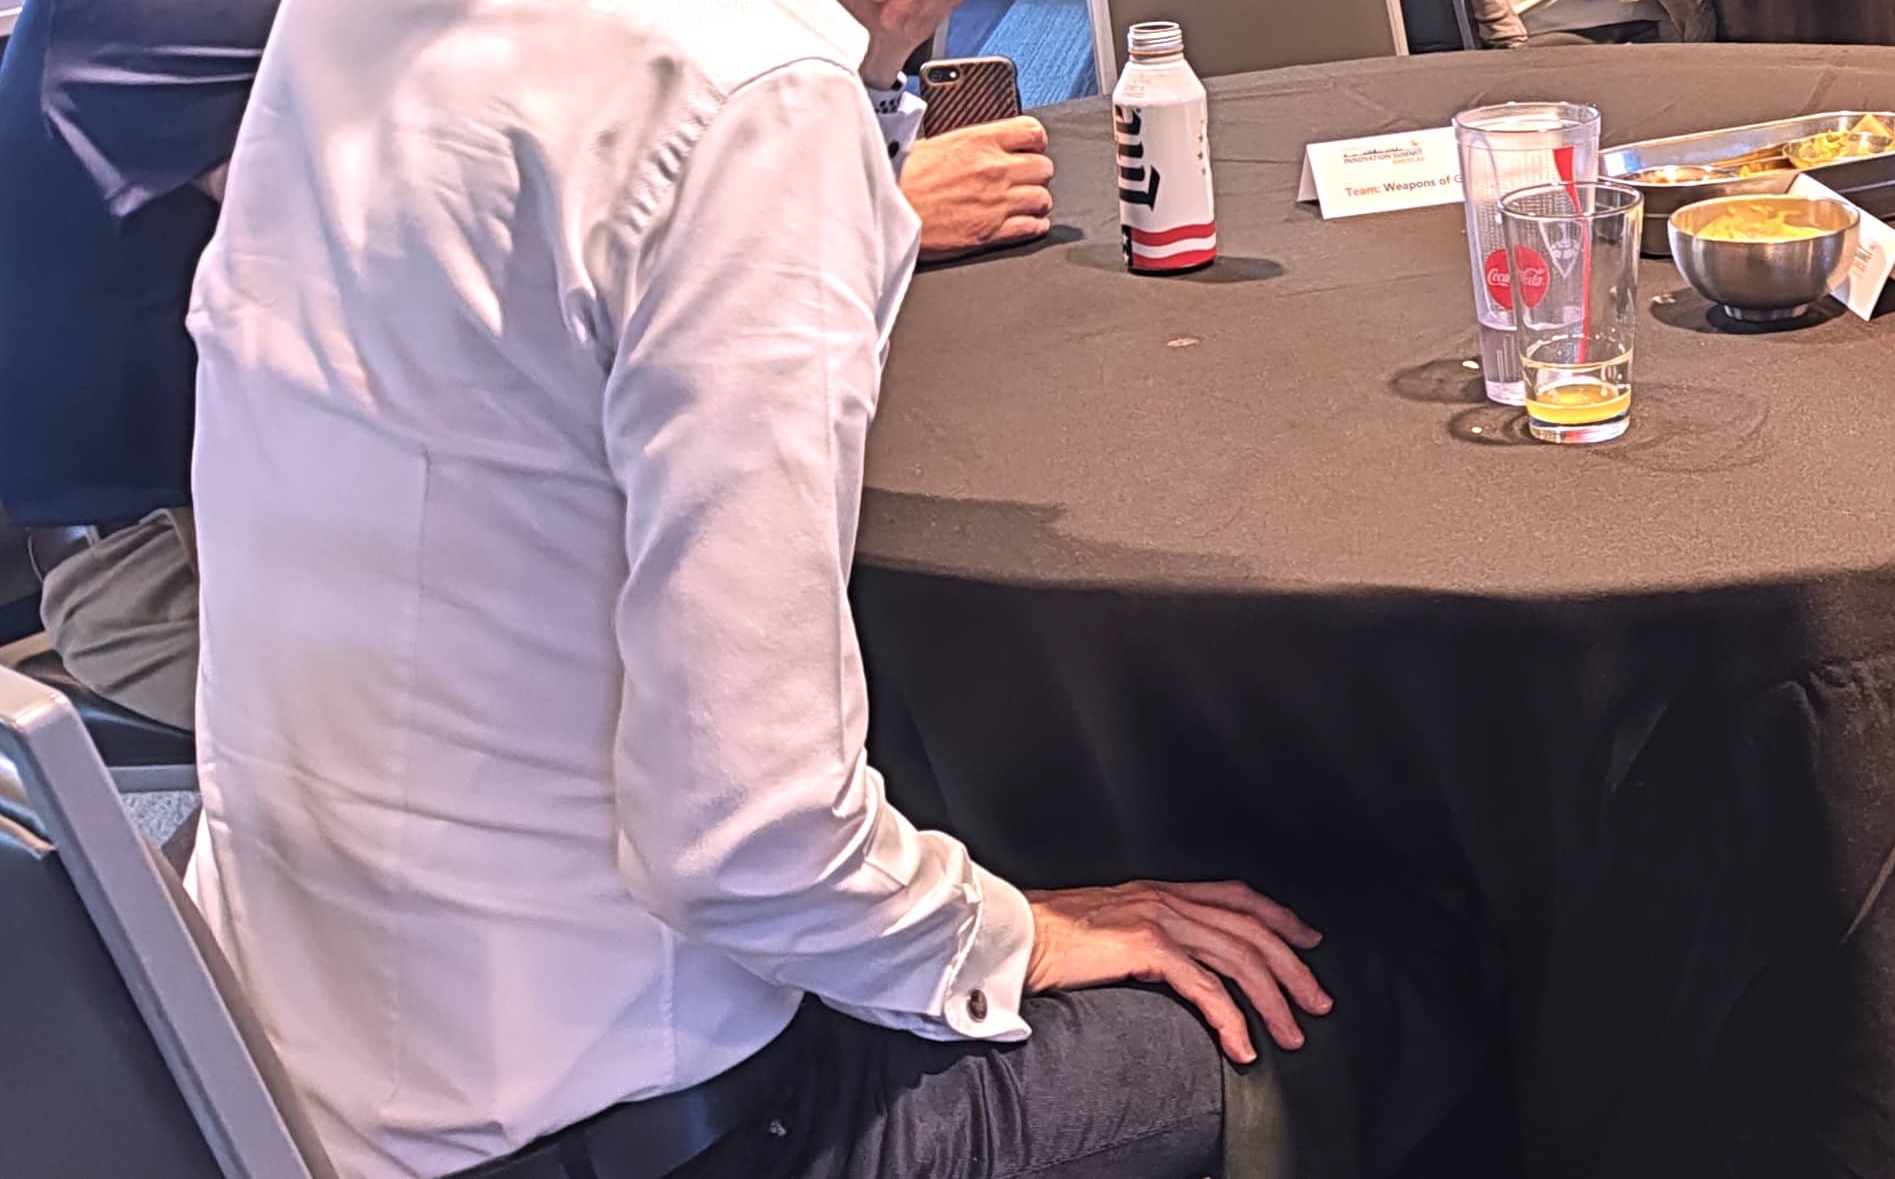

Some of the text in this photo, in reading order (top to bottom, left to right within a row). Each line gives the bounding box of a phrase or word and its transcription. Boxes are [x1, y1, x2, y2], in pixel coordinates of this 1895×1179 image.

[1343, 148, 1423, 164] INNOVATION SUMMIT
[1345, 187, 1381, 197] Team:
[1383, 179, 1436, 192] Weapons
[1438, 174, 1450, 185] of
